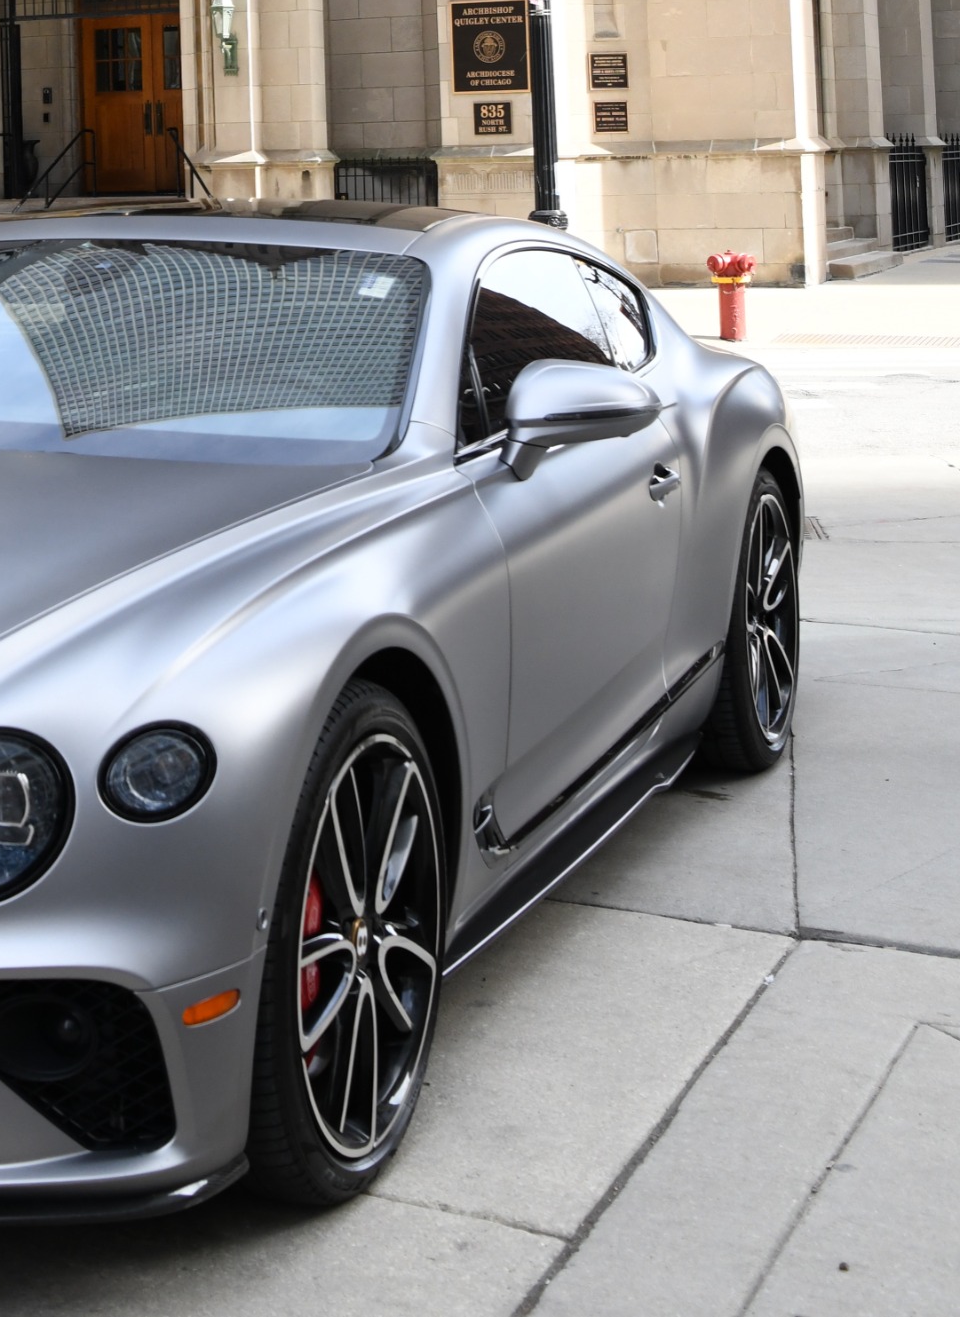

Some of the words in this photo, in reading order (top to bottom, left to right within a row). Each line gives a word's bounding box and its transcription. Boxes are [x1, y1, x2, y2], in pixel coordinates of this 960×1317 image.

[462, 6, 514, 16] ARCHBISHOP
[454, 17, 489, 26] QUIGLEY
[490, 15, 523, 25] CENTER
[466, 70, 515, 78] ARCHDIOCESE
[480, 78, 512, 86] CHICAGO
[480, 104, 505, 118] 835
